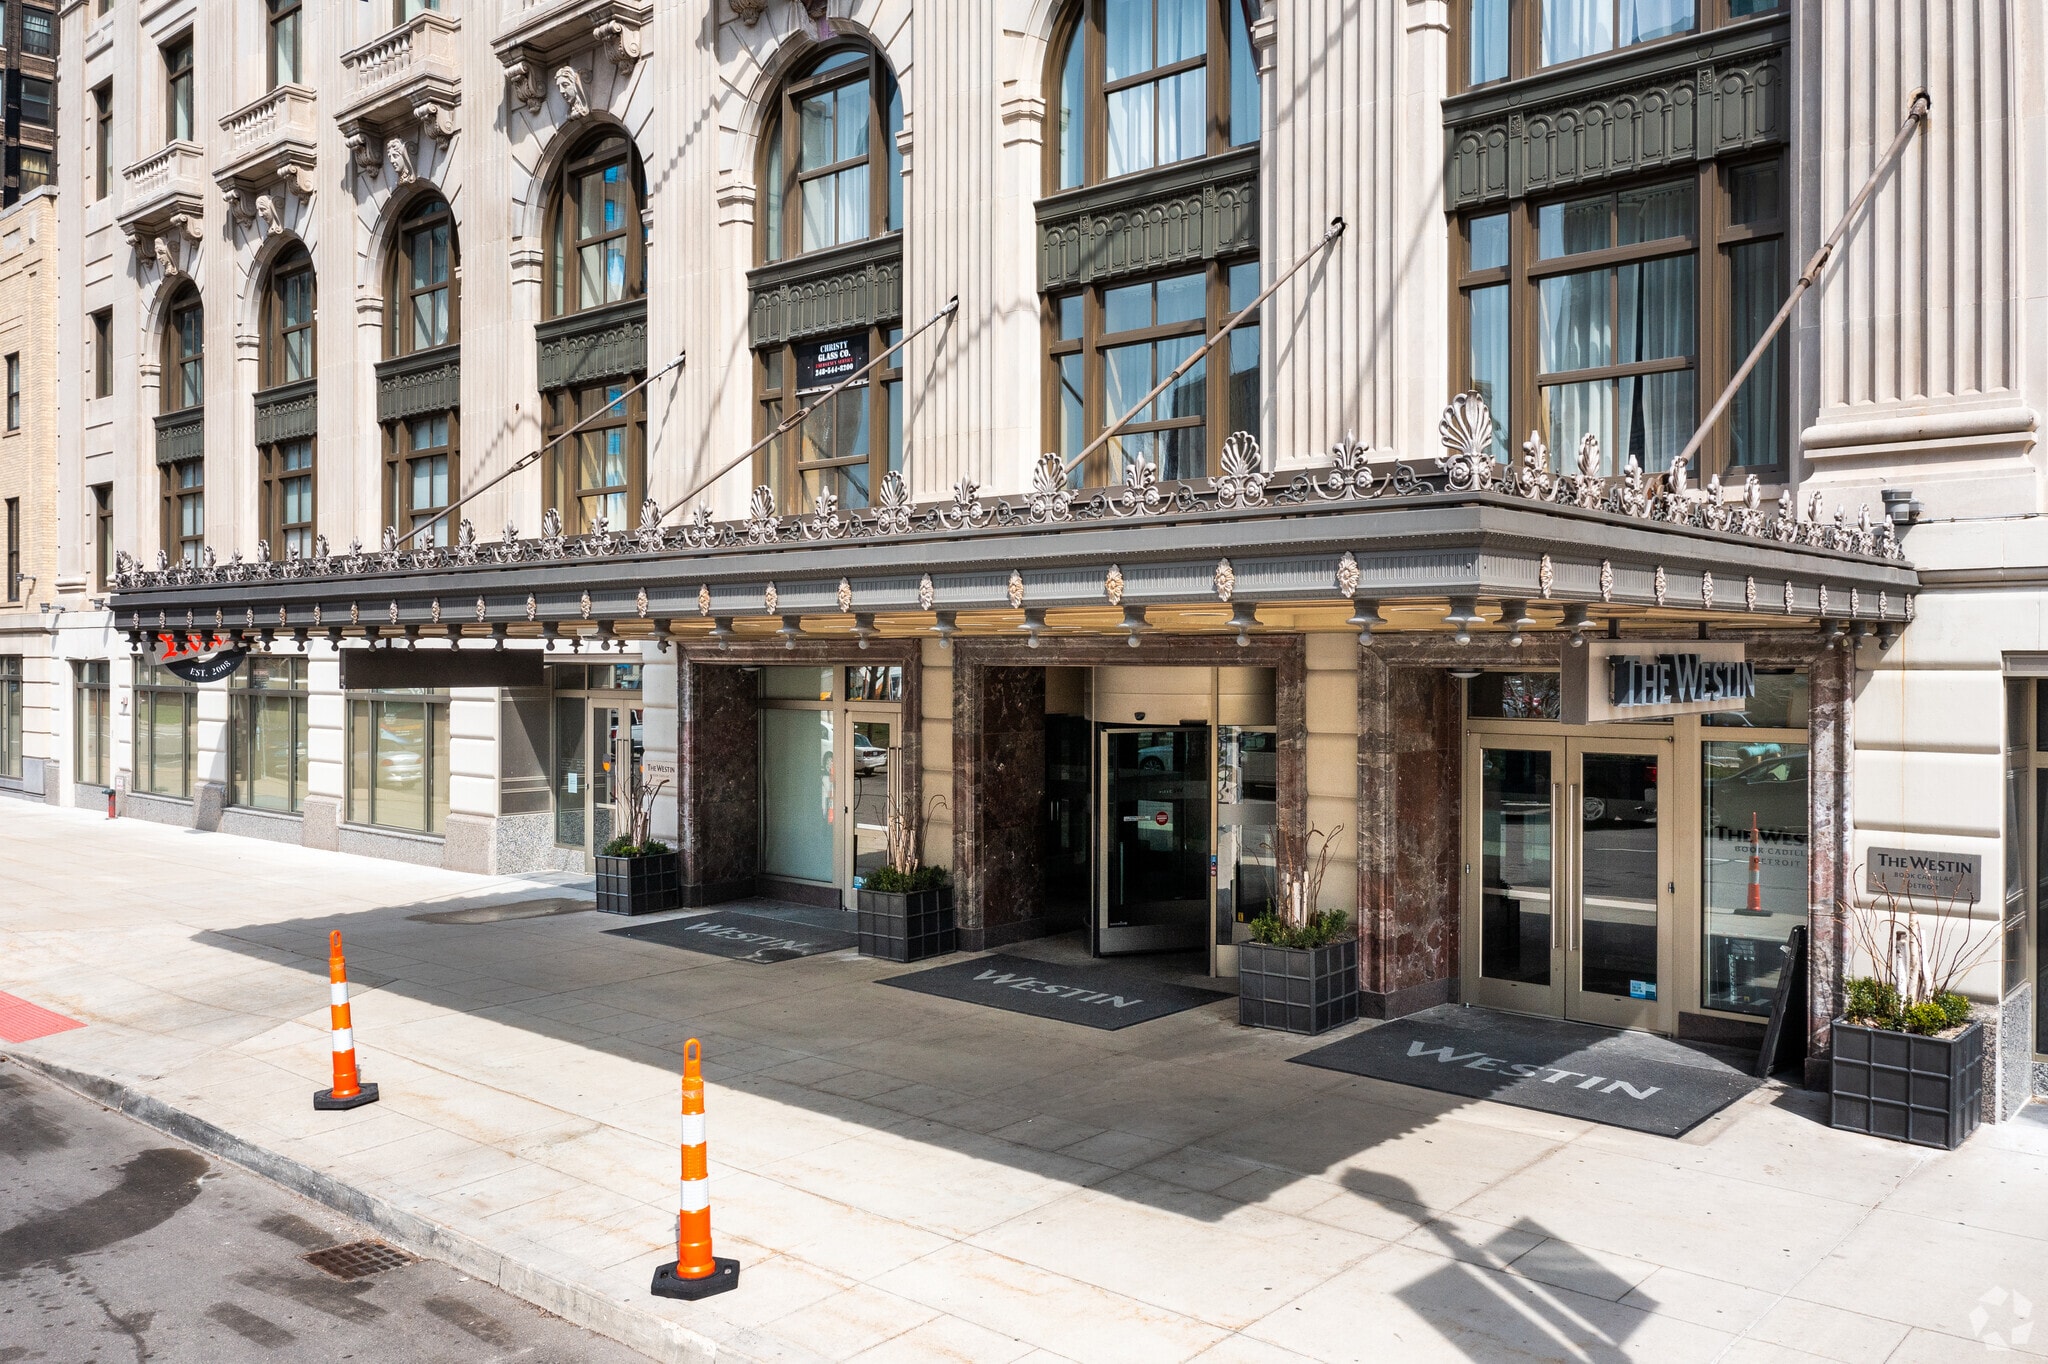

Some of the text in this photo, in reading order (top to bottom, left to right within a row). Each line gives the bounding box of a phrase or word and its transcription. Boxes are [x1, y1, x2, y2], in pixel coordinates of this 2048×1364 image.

[820, 341, 848, 353] CHRISTY
[818, 349, 851, 362] GLASS CO.
[189, 660, 231, 677] EST. 2008
[1617, 653, 1756, 707] THE WESTIN
[657, 764, 675, 773] WESTIN
[1734, 845, 1764, 854] BOOK
[1877, 853, 1972, 874] THE WESTIN
[1894, 871, 1954, 883] BOOK CADILLAC
[1908, 882, 1939, 890] DETROT
[684, 922, 811, 949] WESTIN
[973, 968, 1144, 1008] WESTIN
[1406, 1040, 1663, 1100] WESTIN
